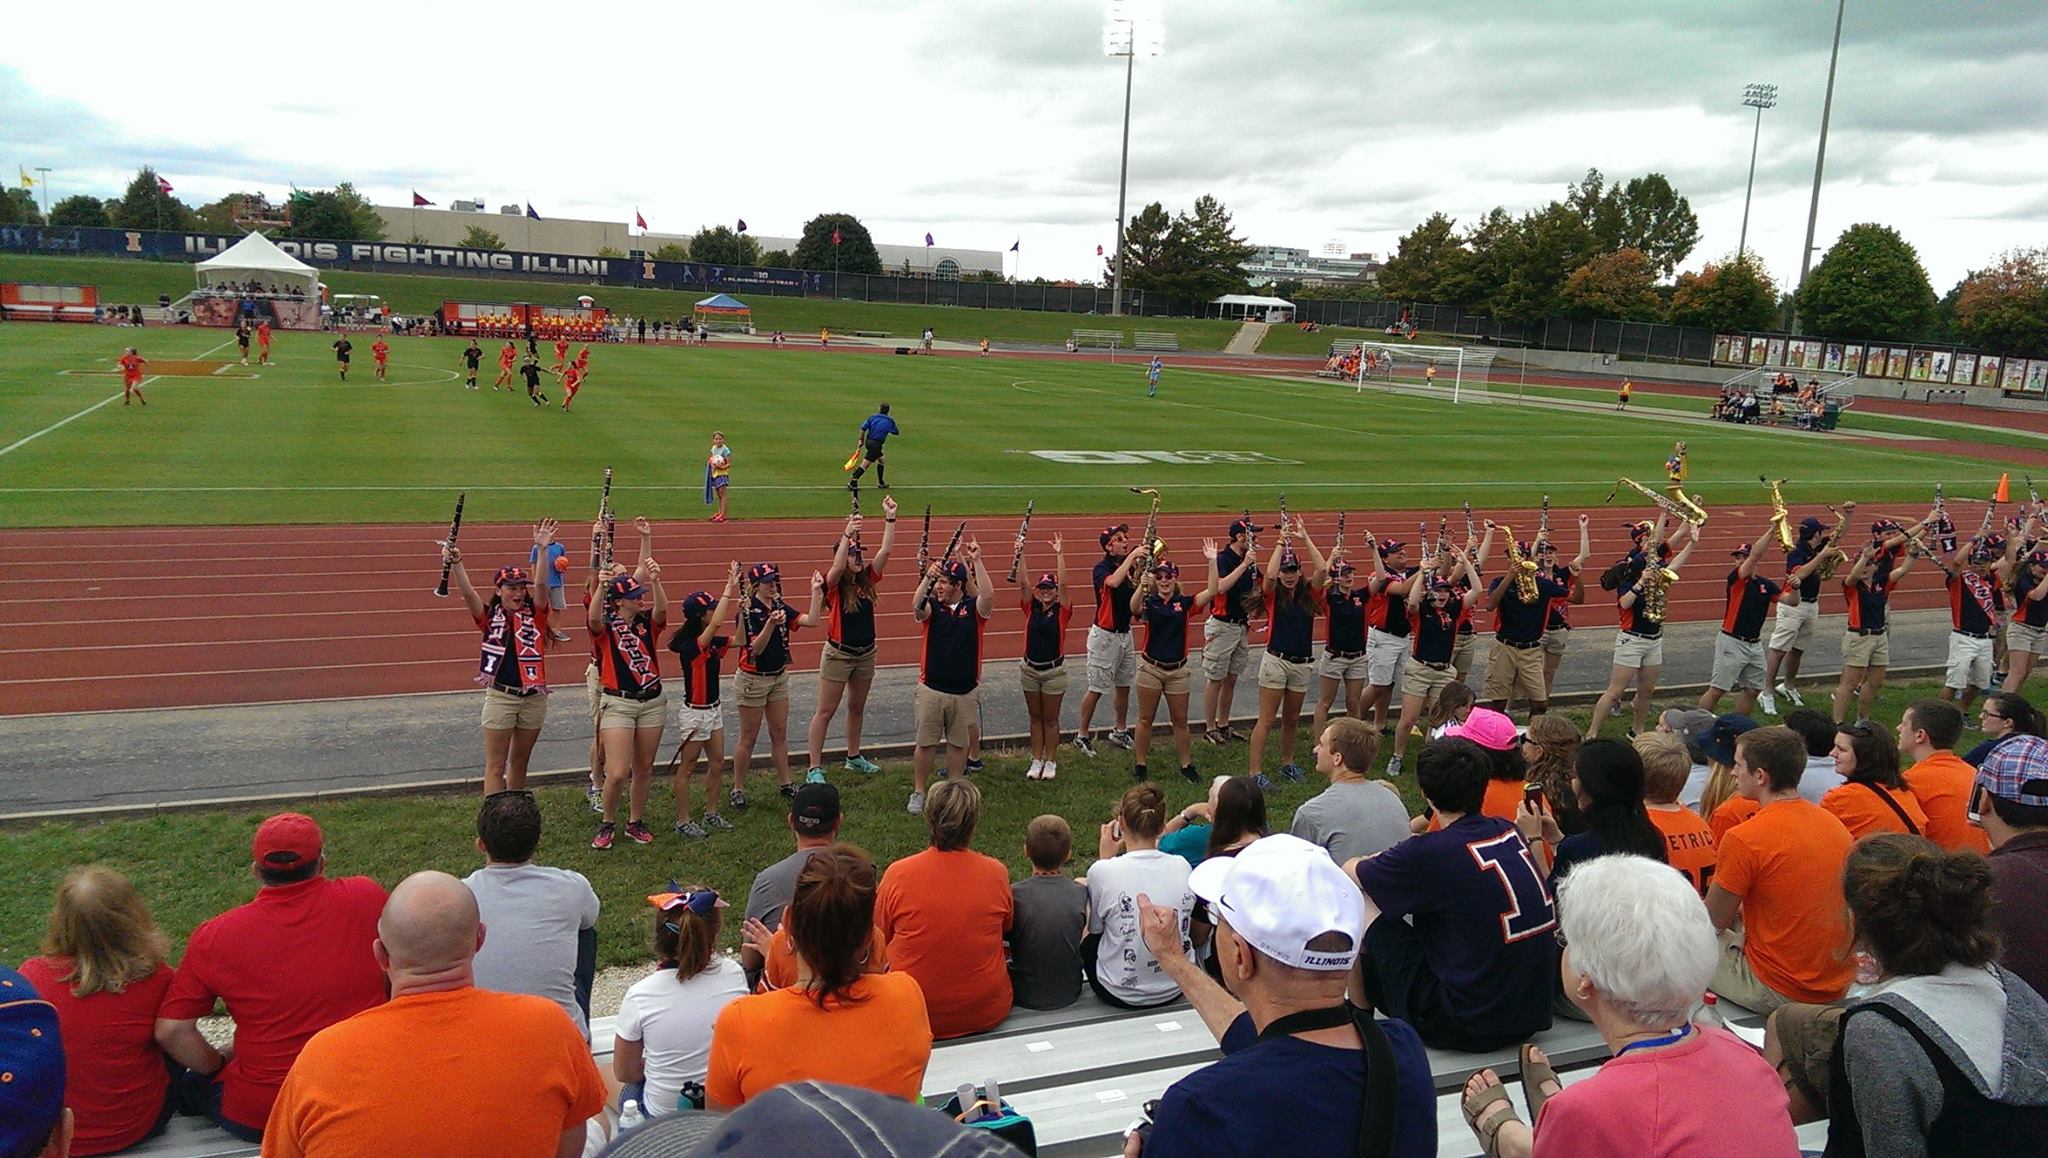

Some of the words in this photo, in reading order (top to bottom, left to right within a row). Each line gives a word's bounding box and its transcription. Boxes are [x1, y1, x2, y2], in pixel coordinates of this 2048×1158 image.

[185, 236, 339, 260] ILOIS
[352, 244, 513, 269] FIGHTING
[522, 255, 608, 276] ILLINI
[1304, 955, 1351, 966] ILLINOIS
